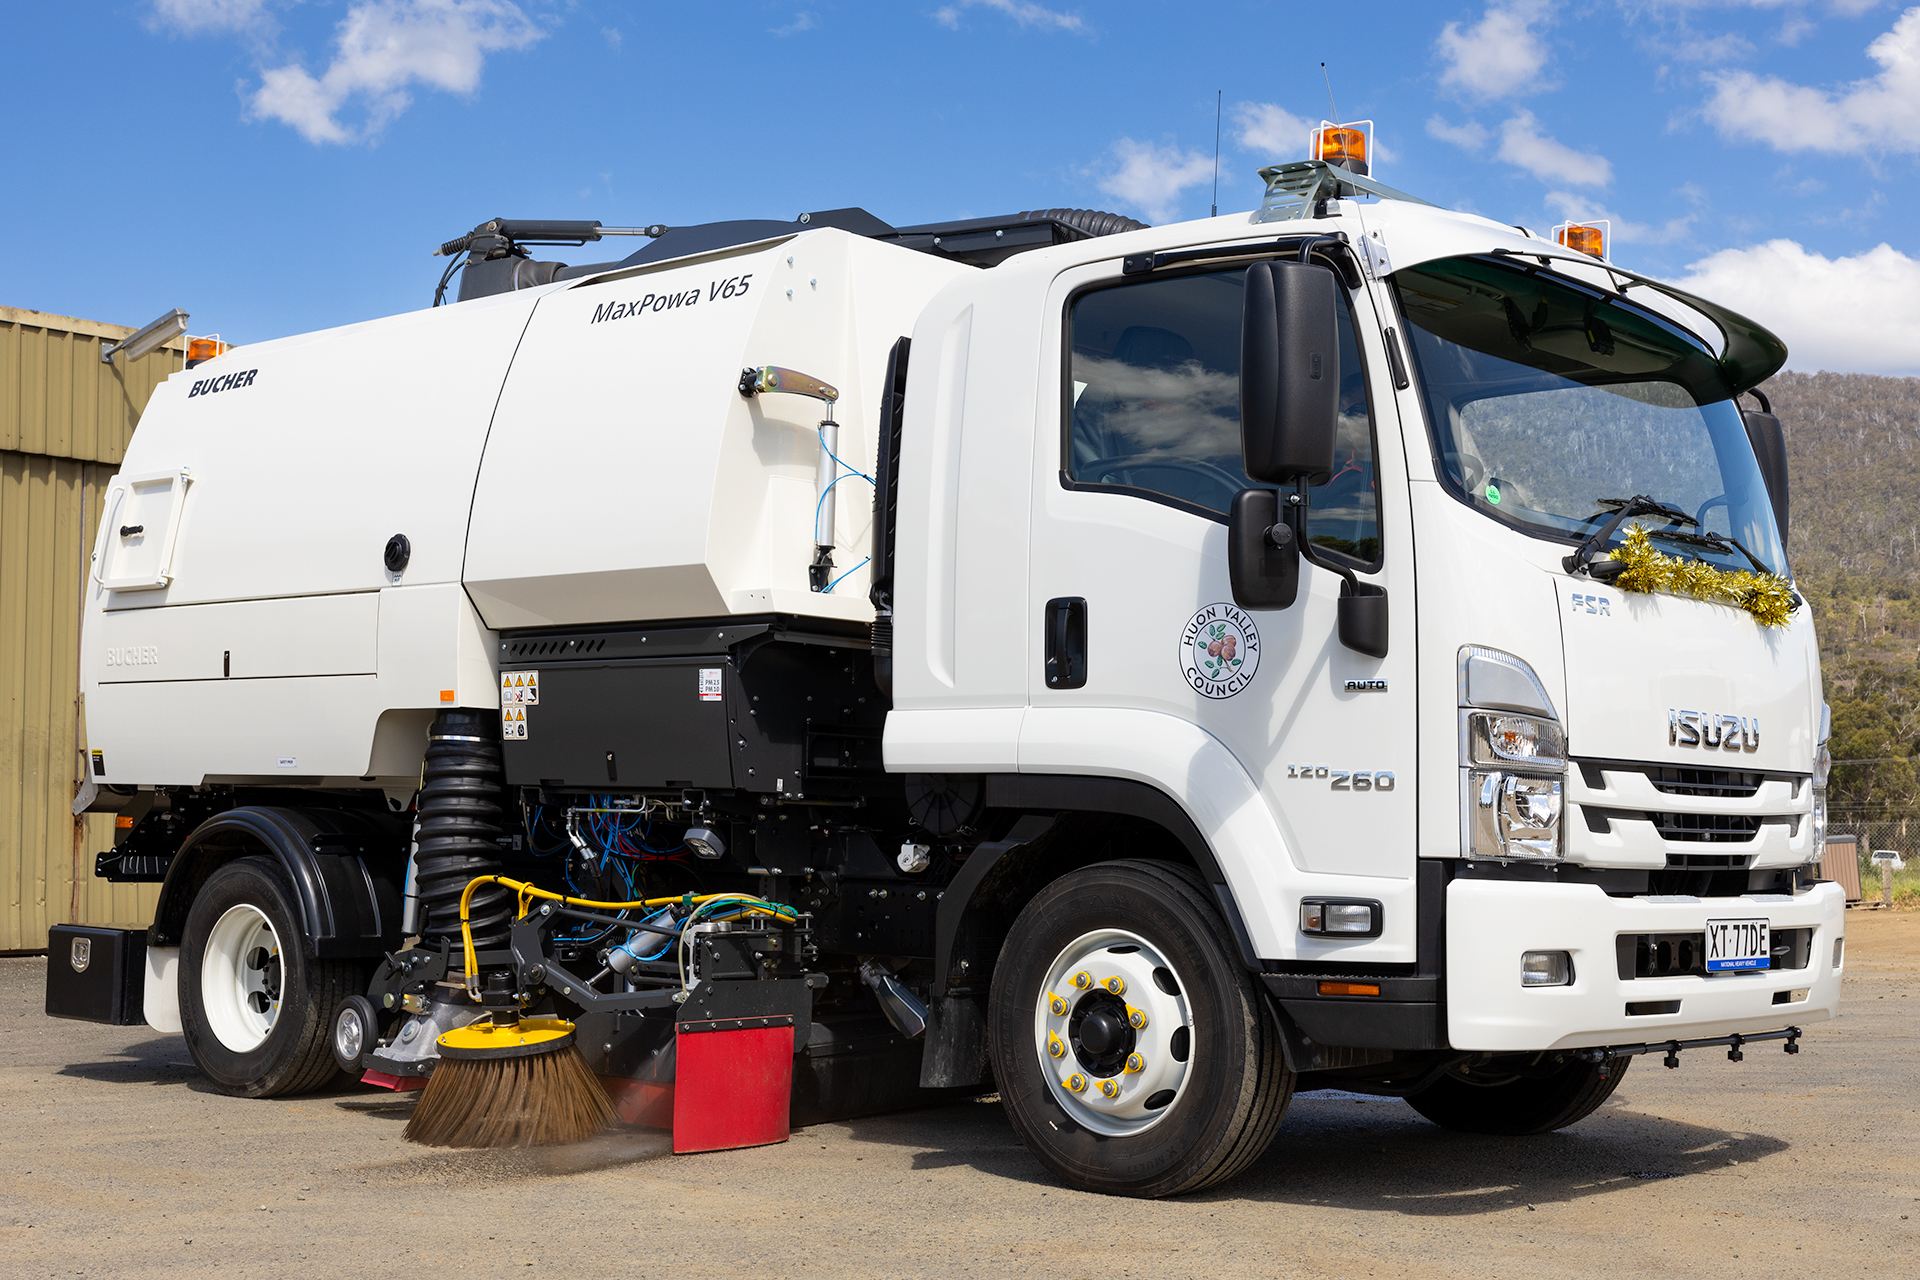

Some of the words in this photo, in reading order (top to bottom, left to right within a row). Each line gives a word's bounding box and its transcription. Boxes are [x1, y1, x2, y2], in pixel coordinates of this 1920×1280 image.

[590, 288, 701, 325] MaxPowa
[709, 273, 753, 302] V65
[187, 368, 259, 399] BUCHER
[1571, 593, 1611, 617] FSR
[1183, 606, 1217, 647] HUON
[1224, 605, 1258, 652] VALLEY
[106, 645, 158, 667] BUCHER
[1186, 667, 1251, 696] COUNCIL
[1347, 680, 1385, 690] AUTO
[1668, 708, 1760, 754] ISUZU
[1287, 764, 1329, 779] 120
[1330, 770, 1395, 792] 260
